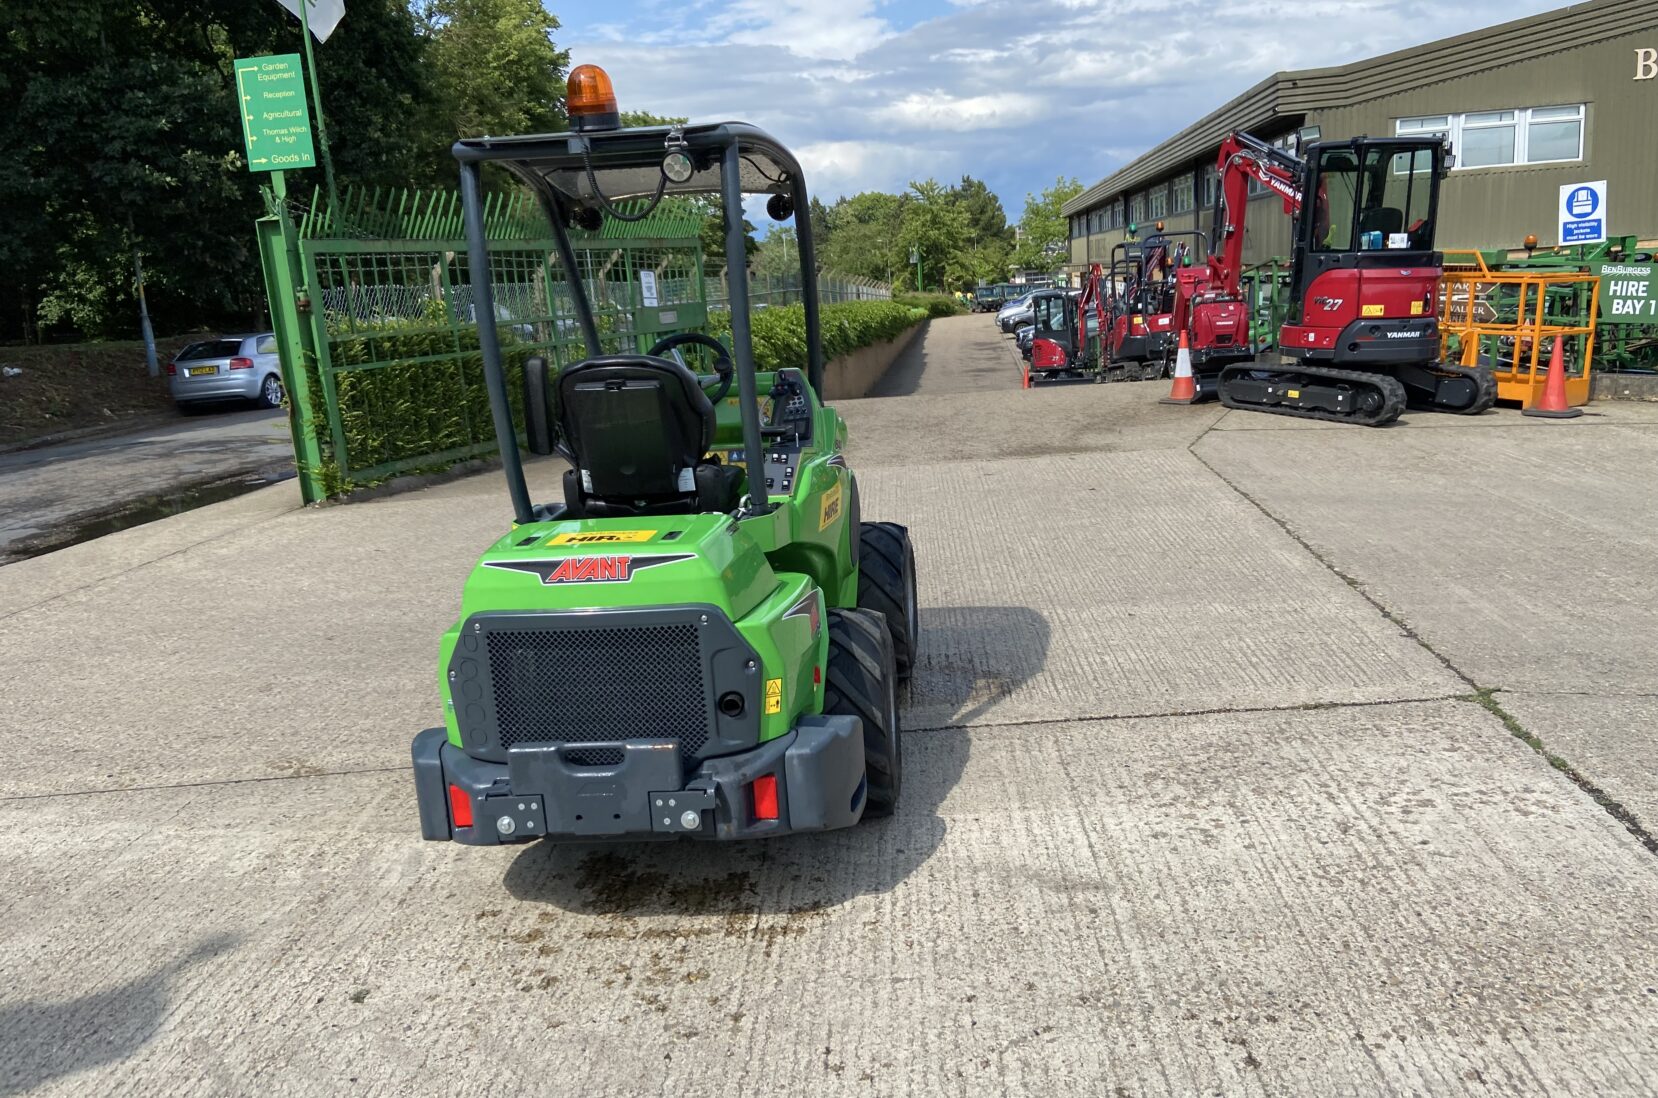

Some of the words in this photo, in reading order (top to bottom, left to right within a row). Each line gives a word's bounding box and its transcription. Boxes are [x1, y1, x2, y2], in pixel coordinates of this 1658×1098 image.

[262, 63, 288, 71] Garden
[257, 71, 295, 81] Equipment
[263, 90, 295, 99] Reception
[263, 109, 302, 120] Agricultural
[263, 128, 288, 136] Thomas
[271, 154, 299, 164] Goods
[301, 153, 310, 161] In
[1609, 280, 1649, 297] HIRE
[1611, 299, 1645, 315] BAY
[1649, 299, 1656, 315] 1
[1386, 331, 1421, 339] YANMAR
[546, 556, 631, 582] AVANT
